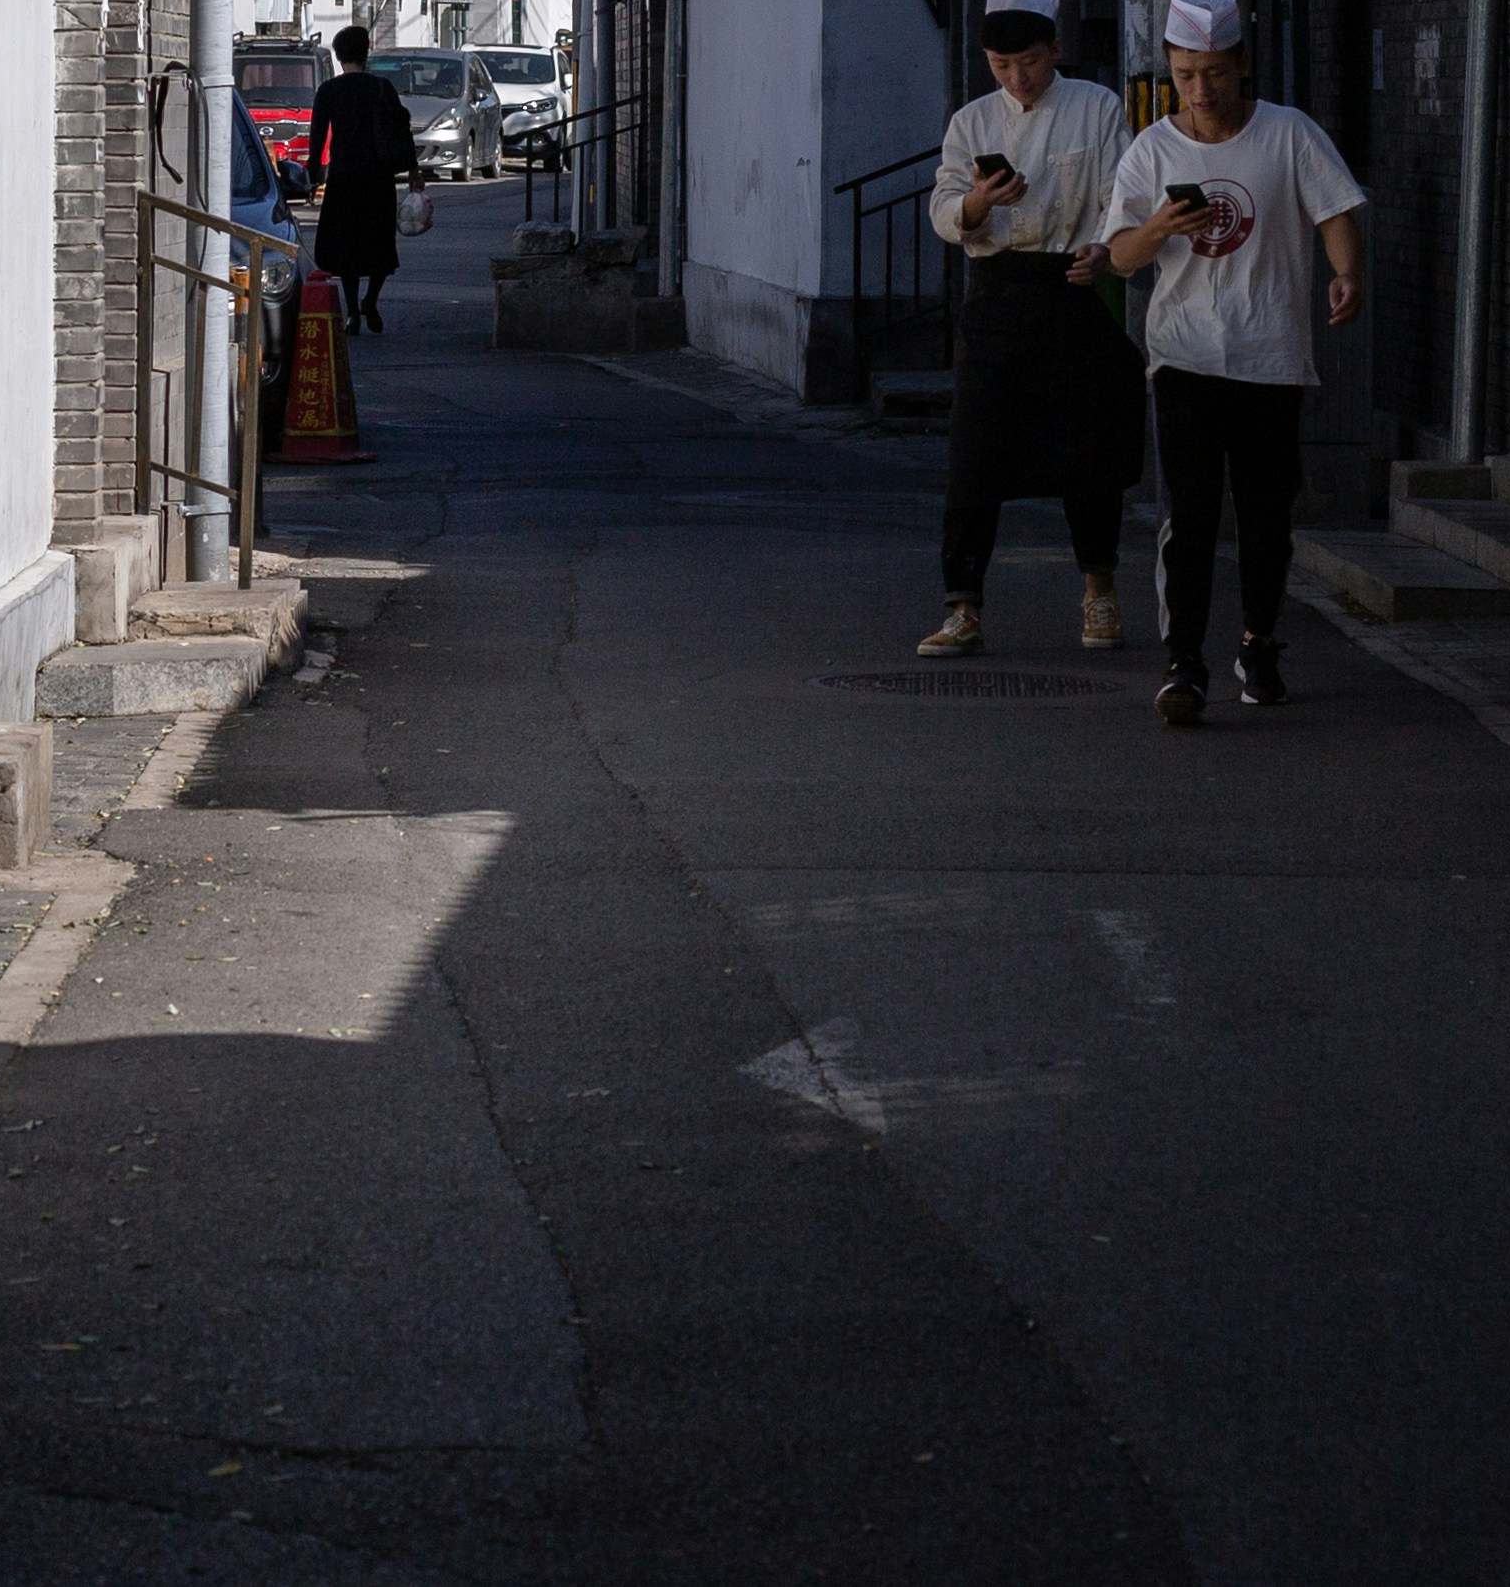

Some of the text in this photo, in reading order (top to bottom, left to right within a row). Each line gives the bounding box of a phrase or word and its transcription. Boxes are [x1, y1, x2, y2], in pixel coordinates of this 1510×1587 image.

[297, 320, 320, 429] 潜水艇地漏
